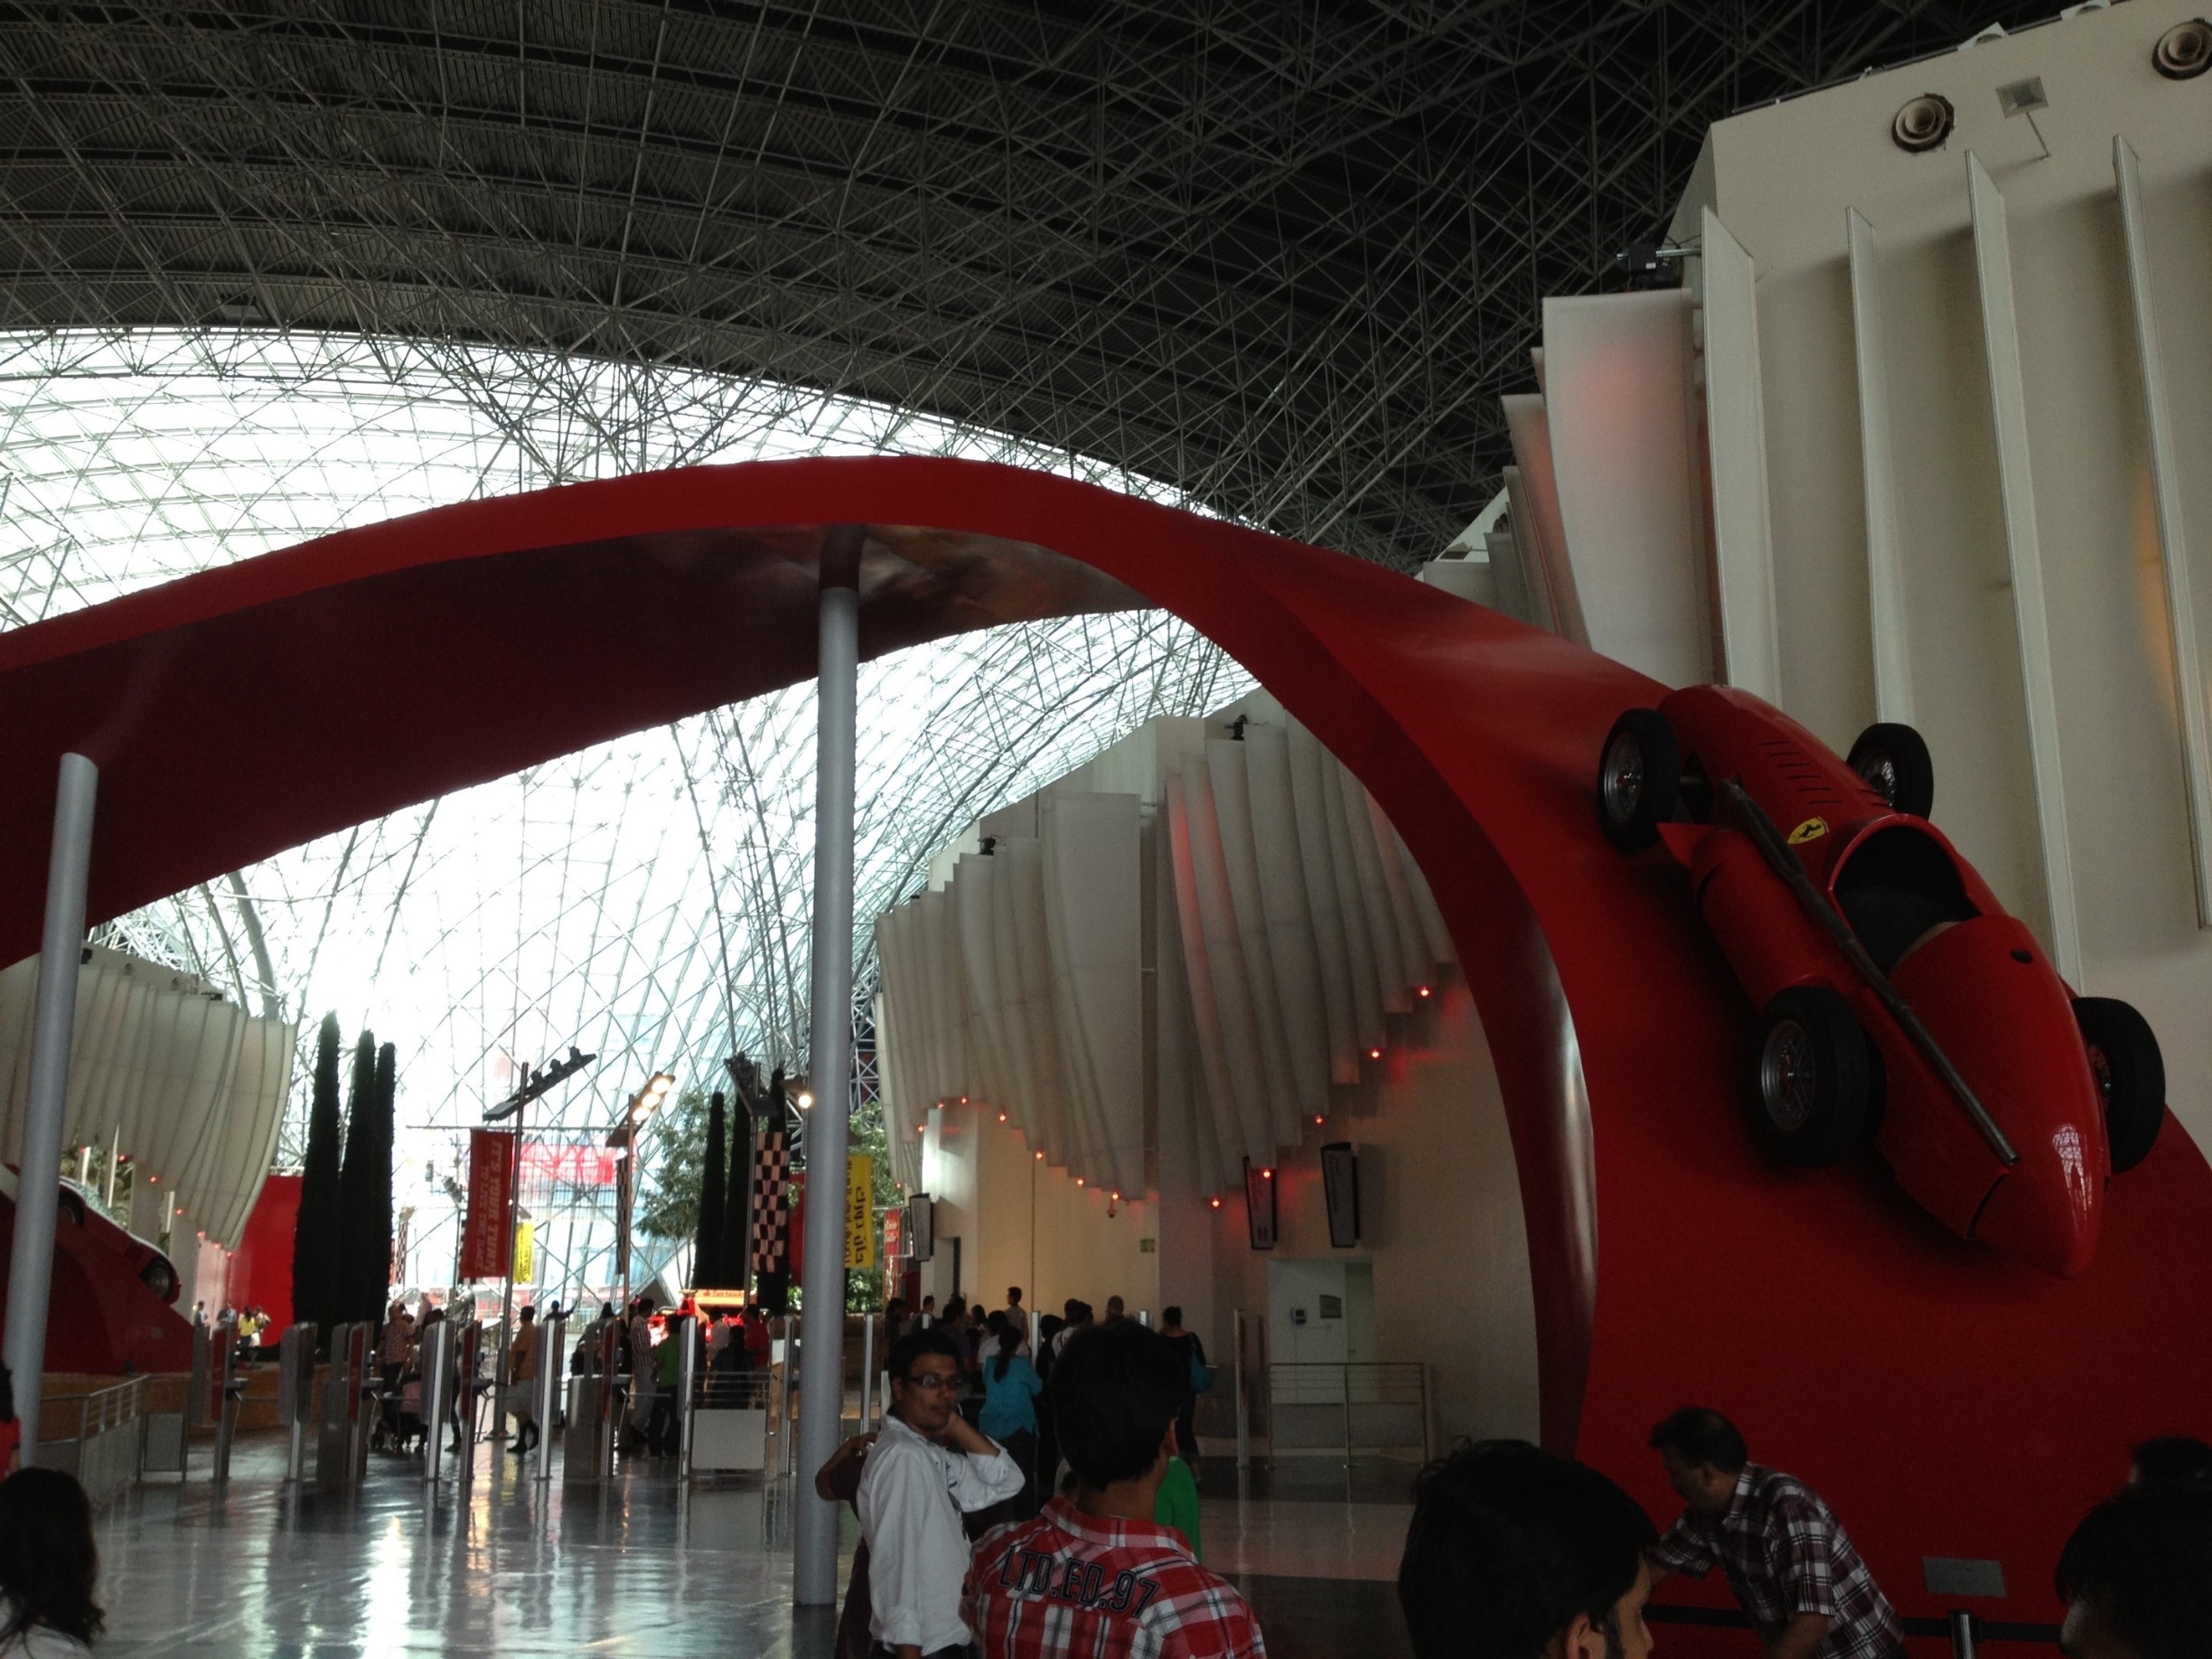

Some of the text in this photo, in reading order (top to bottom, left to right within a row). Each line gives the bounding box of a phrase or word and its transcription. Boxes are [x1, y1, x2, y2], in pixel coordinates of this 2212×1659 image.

[479, 1182, 489, 1208] LIVE
[489, 1177, 501, 1220] YOUR
[477, 1213, 487, 1235] THE
[485, 1224, 498, 1273] TURN
[998, 1544, 1160, 1619] LTD.ED.97
